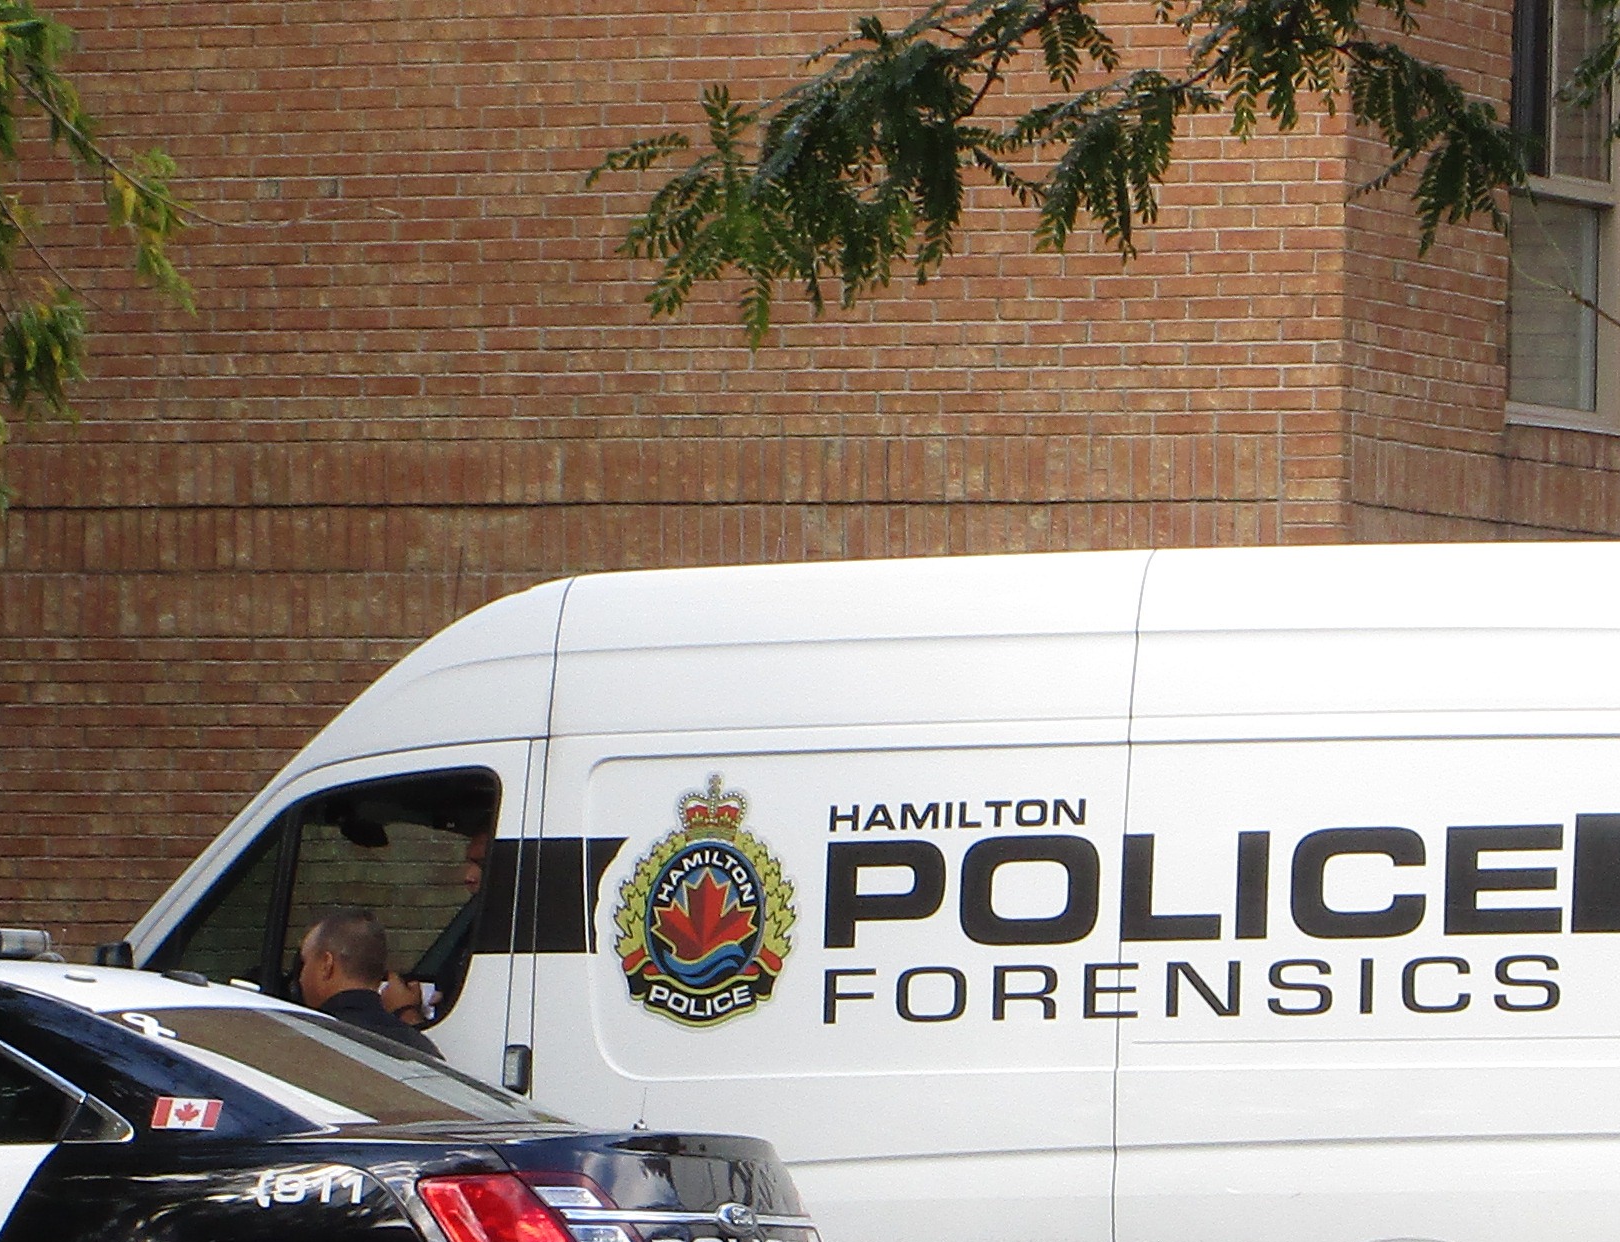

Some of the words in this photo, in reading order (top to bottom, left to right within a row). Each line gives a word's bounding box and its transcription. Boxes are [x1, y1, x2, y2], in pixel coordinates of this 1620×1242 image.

[829, 798, 1087, 832] HAMILTON
[657, 849, 757, 903] HAMILTON
[823, 824, 1564, 950] POLICE
[648, 984, 753, 1017] POLICE
[823, 954, 1564, 1024] FORENSICS
